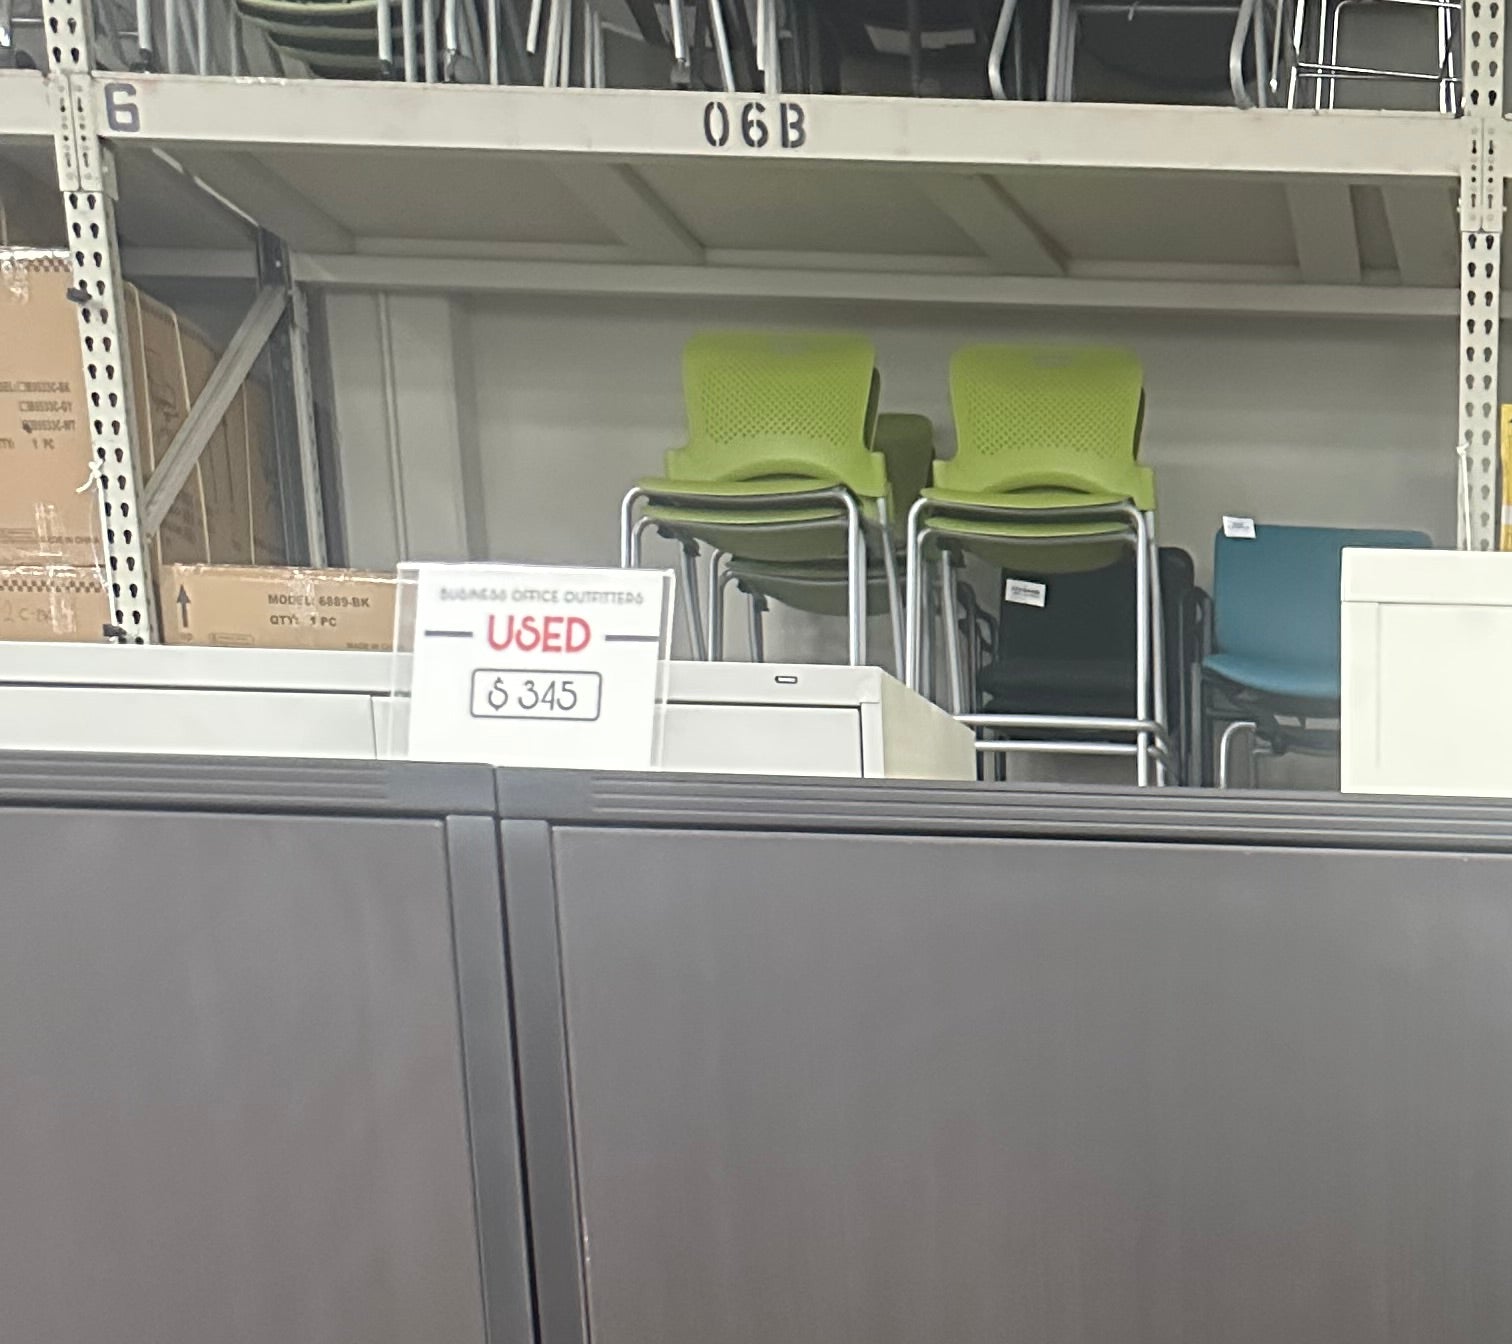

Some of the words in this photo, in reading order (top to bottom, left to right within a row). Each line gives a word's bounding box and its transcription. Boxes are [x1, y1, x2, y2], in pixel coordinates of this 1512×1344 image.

[104, 83, 140, 132] 6
[703, 101, 806, 148] 06B
[440, 587, 508, 602] BUSINESS
[511, 589, 559, 604] OFFICE
[564, 591, 645, 605] OUTFITTERS
[320, 616, 337, 627] PC
[486, 614, 592, 653] USED
[487, 677, 509, 711] $
[517, 679, 578, 711] 345
